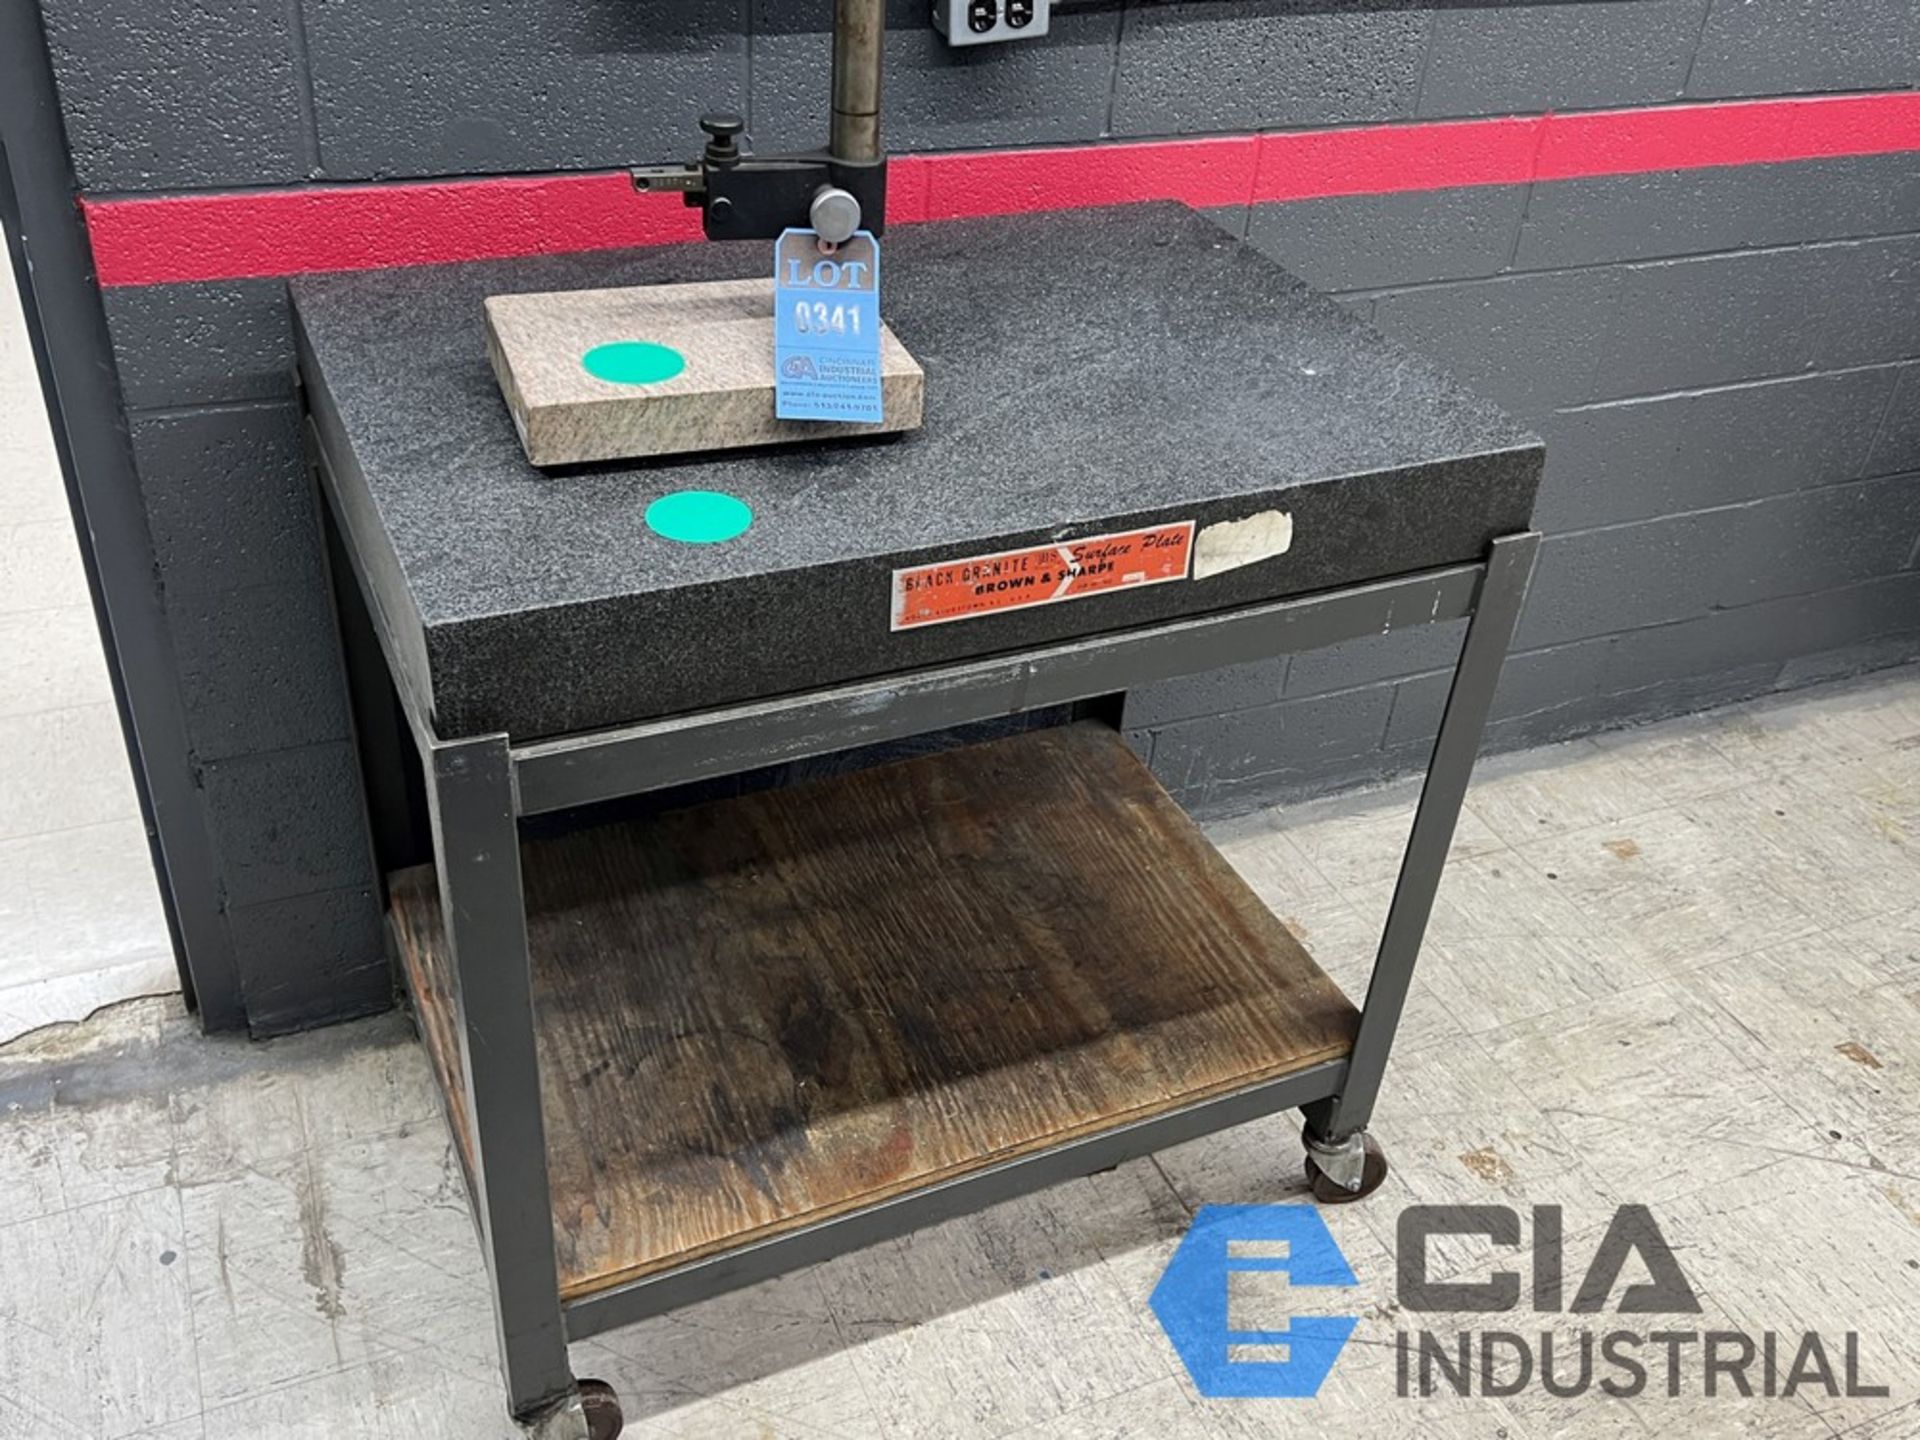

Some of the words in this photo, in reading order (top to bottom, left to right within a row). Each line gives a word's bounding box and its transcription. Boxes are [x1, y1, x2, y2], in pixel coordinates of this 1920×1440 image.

[788, 259, 867, 288] LOT
[796, 301, 861, 334] 0341
[819, 365, 877, 375] INDUSTRIAL
[962, 557, 1028, 581] GRANITE
[1070, 543, 1132, 563] Surface
[1141, 533, 1185, 551] Plate
[975, 576, 1036, 595] BROWN
[1041, 573, 1051, 583] &
[1058, 562, 1115, 581] SHARPE
